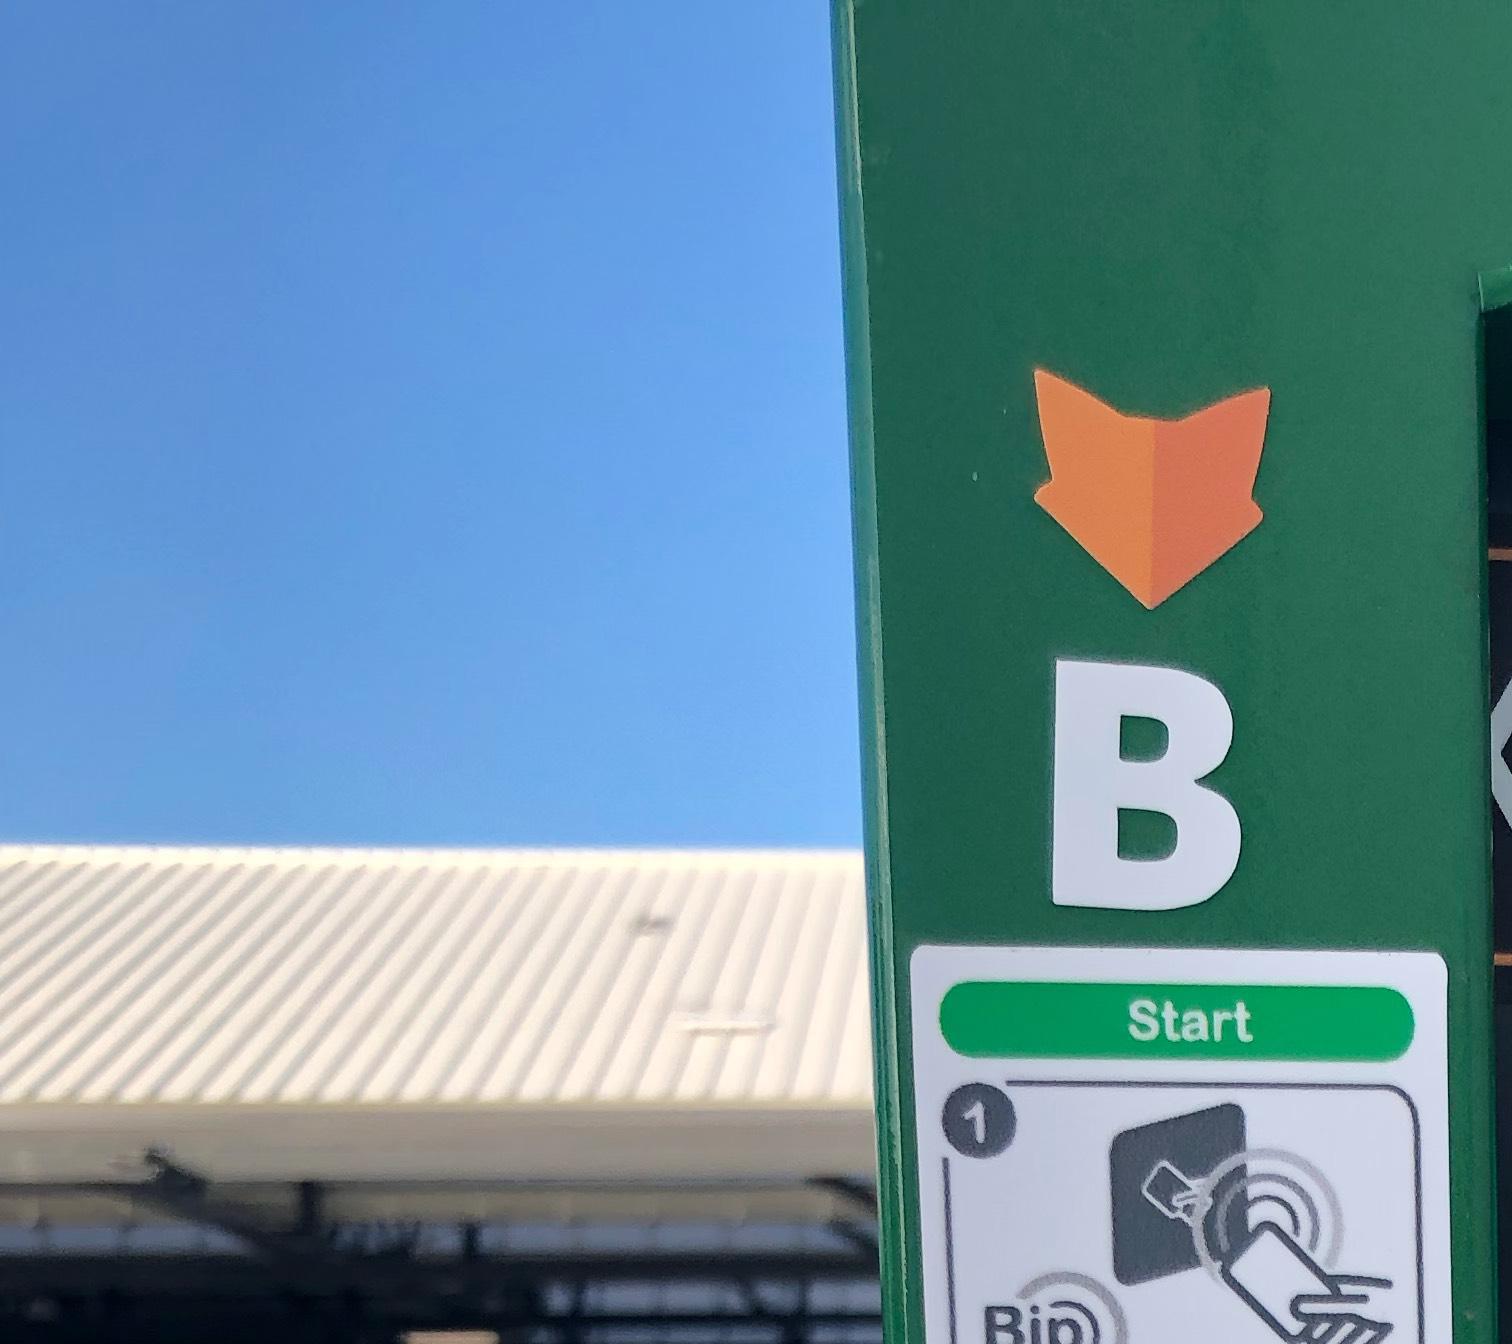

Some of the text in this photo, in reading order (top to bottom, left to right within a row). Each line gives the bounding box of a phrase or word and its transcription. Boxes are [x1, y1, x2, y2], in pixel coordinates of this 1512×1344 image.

[1052, 658, 1242, 911] B
[1128, 997, 1254, 1043] Start
[962, 1101, 988, 1145] 1
